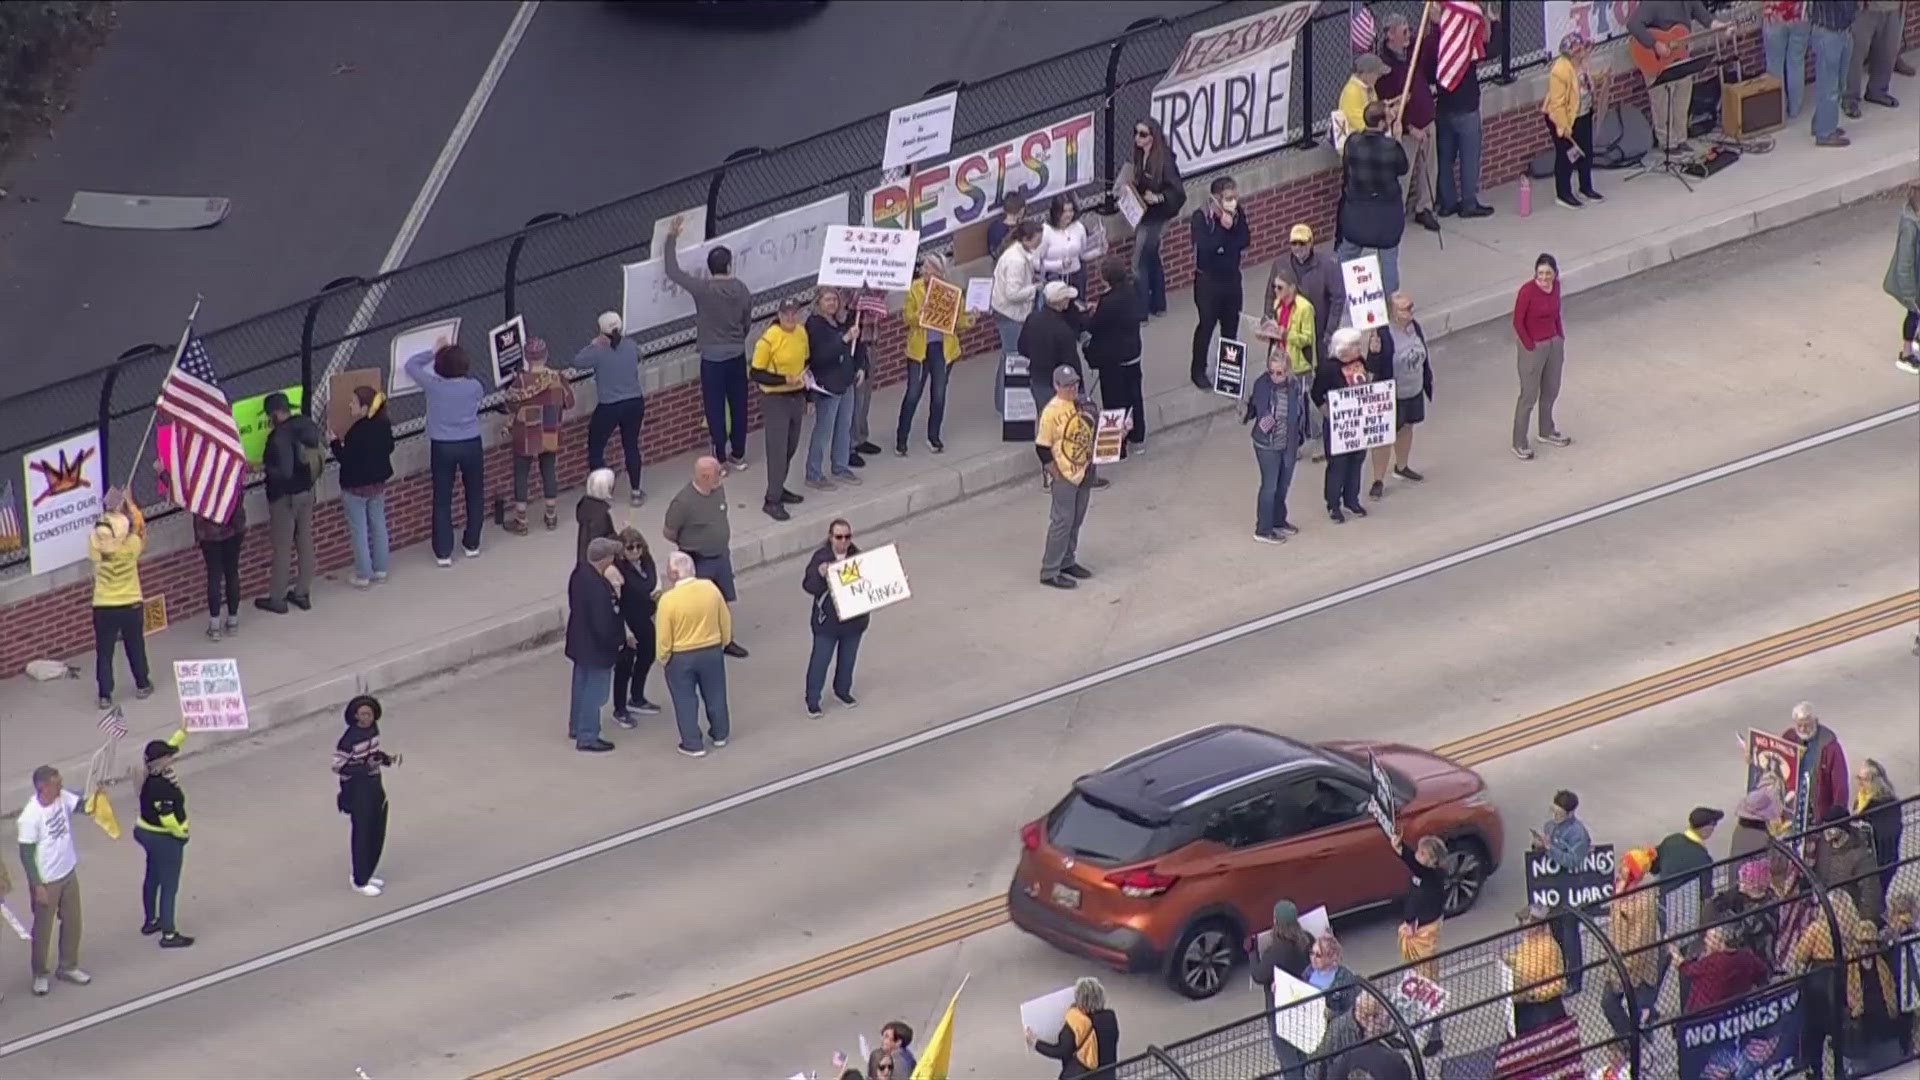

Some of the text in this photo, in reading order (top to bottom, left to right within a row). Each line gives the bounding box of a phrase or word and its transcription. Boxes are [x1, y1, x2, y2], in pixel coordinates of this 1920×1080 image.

[1153, 61, 1290, 161] TROUBLE
[872, 115, 1092, 237] RESIST
[850, 245, 889, 256] A society
[829, 256, 869, 266] grounded
[866, 270, 896, 278] survive
[1340, 386, 1373, 399] TWINKLE
[1358, 391, 1390, 406] TWINKLE
[1333, 408, 1363, 420] LITTLE
[1333, 415, 1383, 432] PUTIN PUT
[1338, 423, 1390, 440] YOU WHERE
[1344, 435, 1384, 450] YOU ARE
[37, 495, 97, 524] DEFEND OUR
[33, 513, 102, 543] CONSTITUTION
[849, 580, 872, 597] NO
[867, 581, 904, 604] KINGS
[1532, 851, 1615, 878] NO NGS
[1533, 888, 1560, 907] NO
[1684, 1022, 1717, 1049] NO
[1719, 1001, 1780, 1041] KINGS
